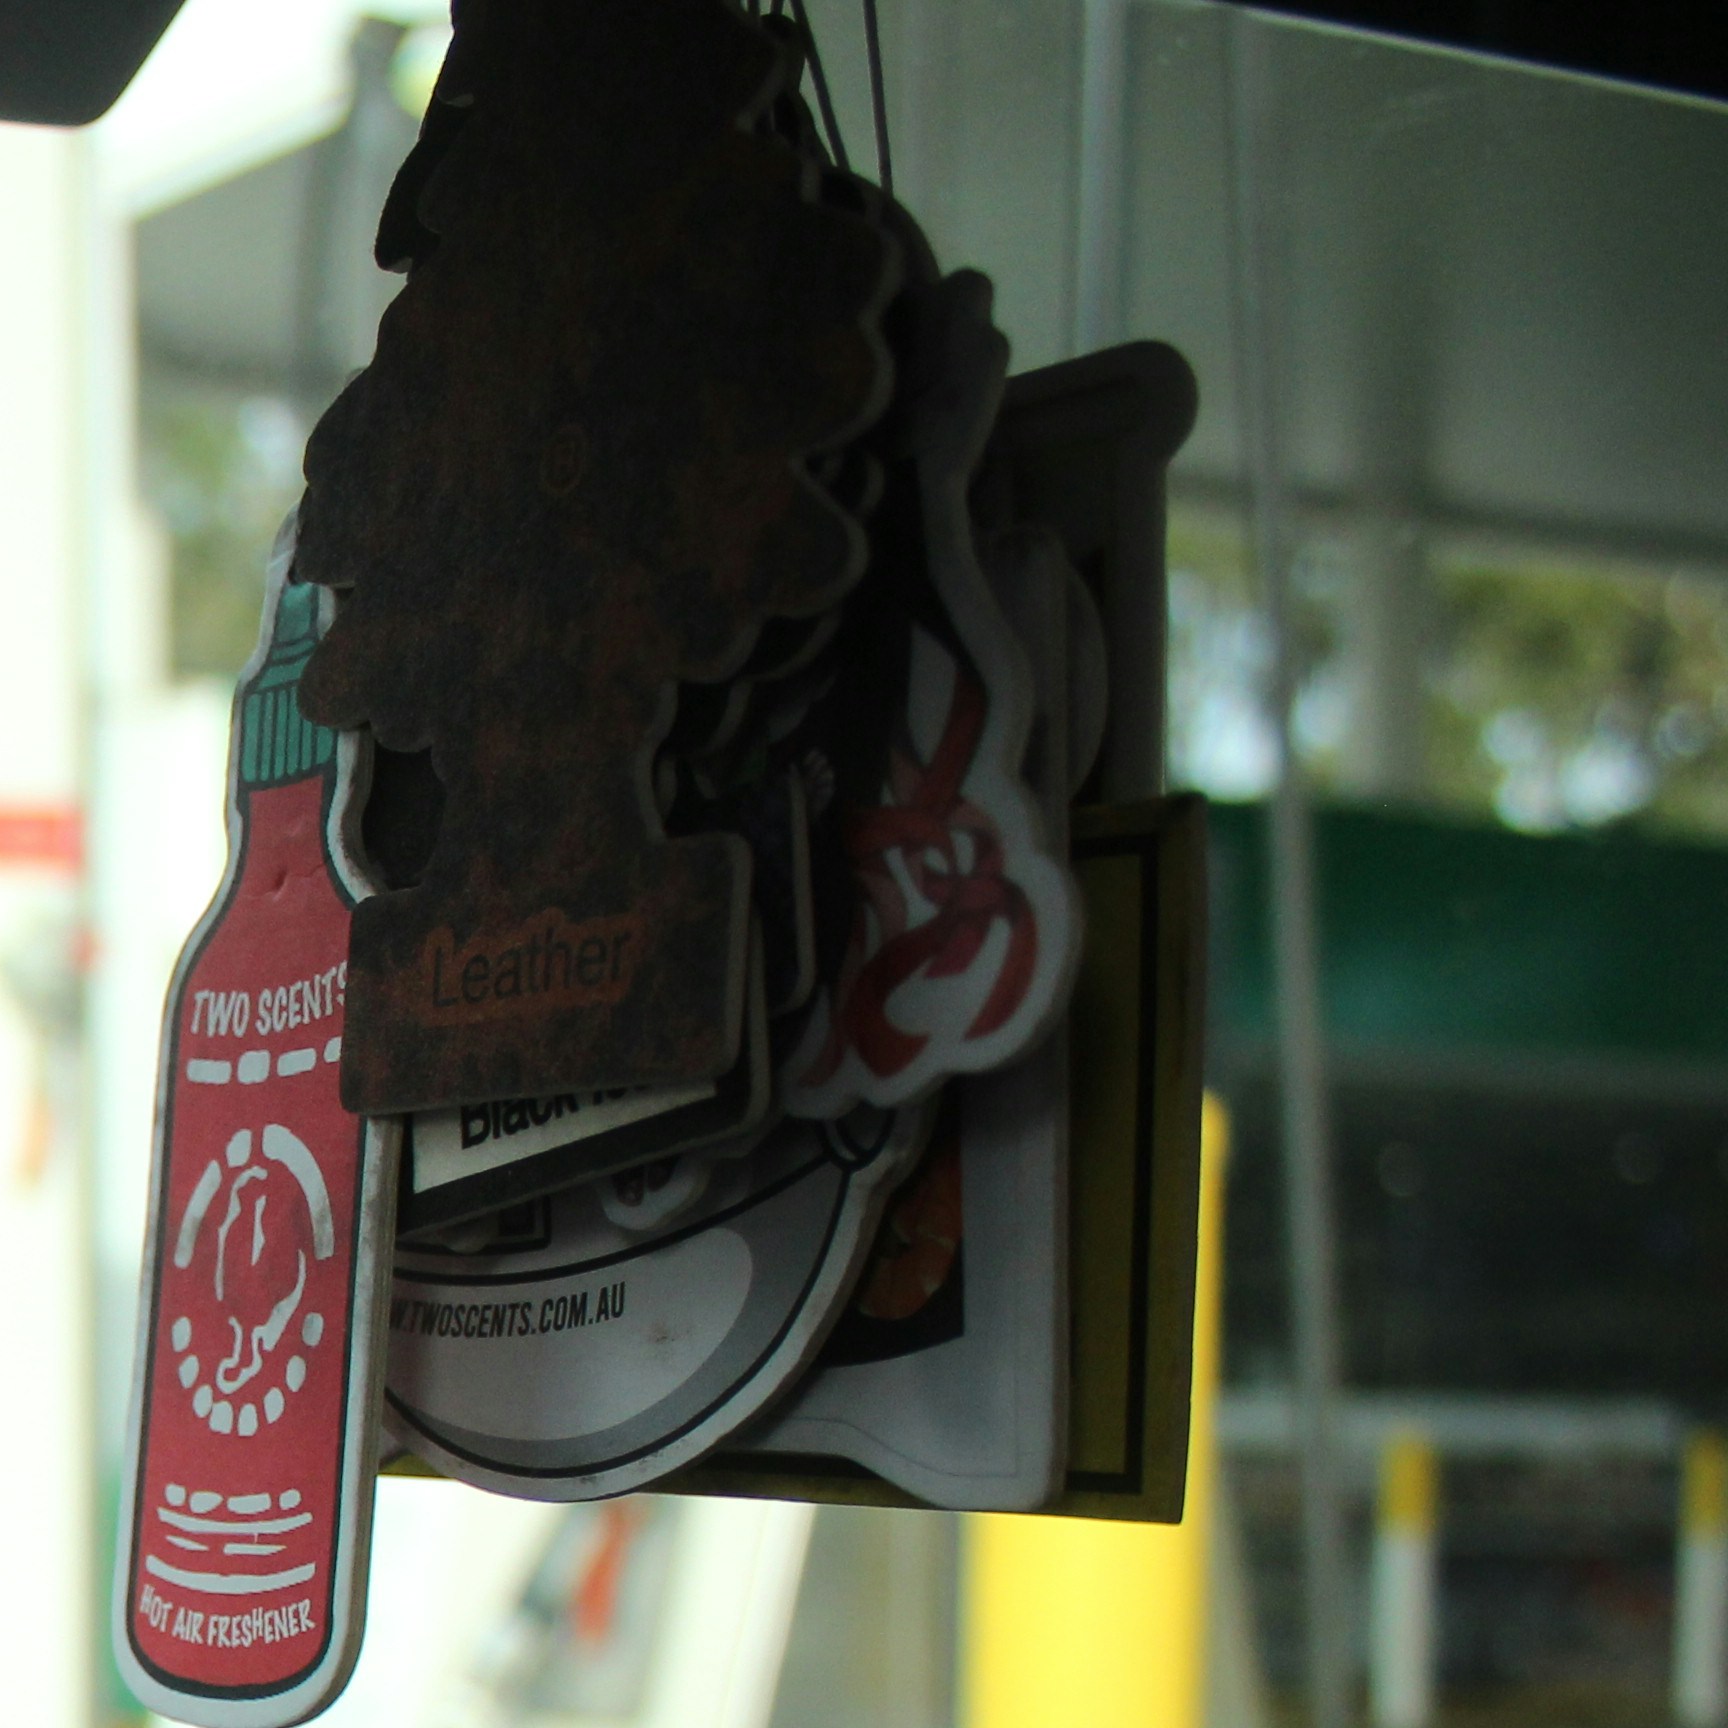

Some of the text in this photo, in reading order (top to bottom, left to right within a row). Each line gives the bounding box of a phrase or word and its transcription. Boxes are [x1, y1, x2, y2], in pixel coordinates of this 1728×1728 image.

[431, 927, 631, 1008] Leather
[190, 989, 250, 1038] TWO
[140, 1584, 315, 1648] HOT AIR FRESHENER
